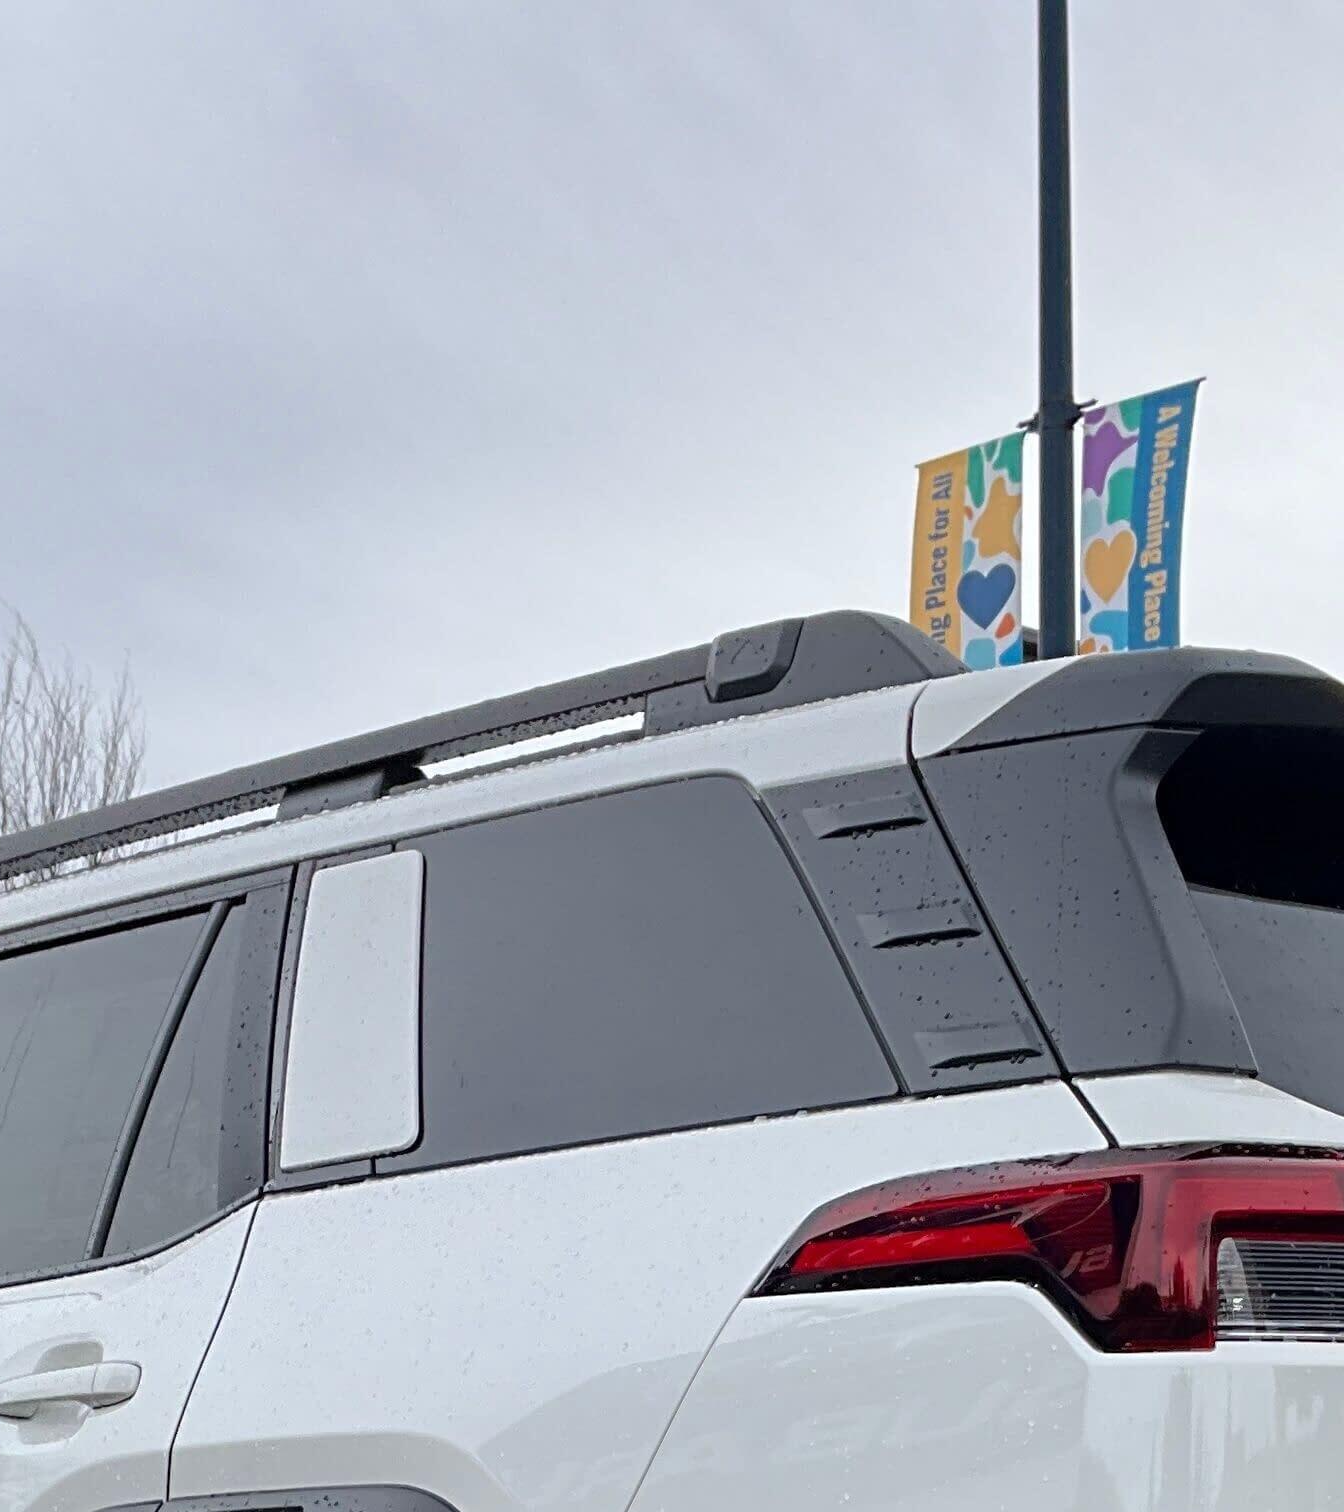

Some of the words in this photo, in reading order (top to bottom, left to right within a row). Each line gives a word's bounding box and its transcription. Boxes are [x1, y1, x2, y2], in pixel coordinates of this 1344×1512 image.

[1158, 405, 1182, 424] A
[932, 471, 954, 501] All
[1140, 423, 1179, 568] Welcoming
[928, 507, 951, 541] for
[925, 545, 948, 611] Place
[1144, 569, 1168, 643] Place
